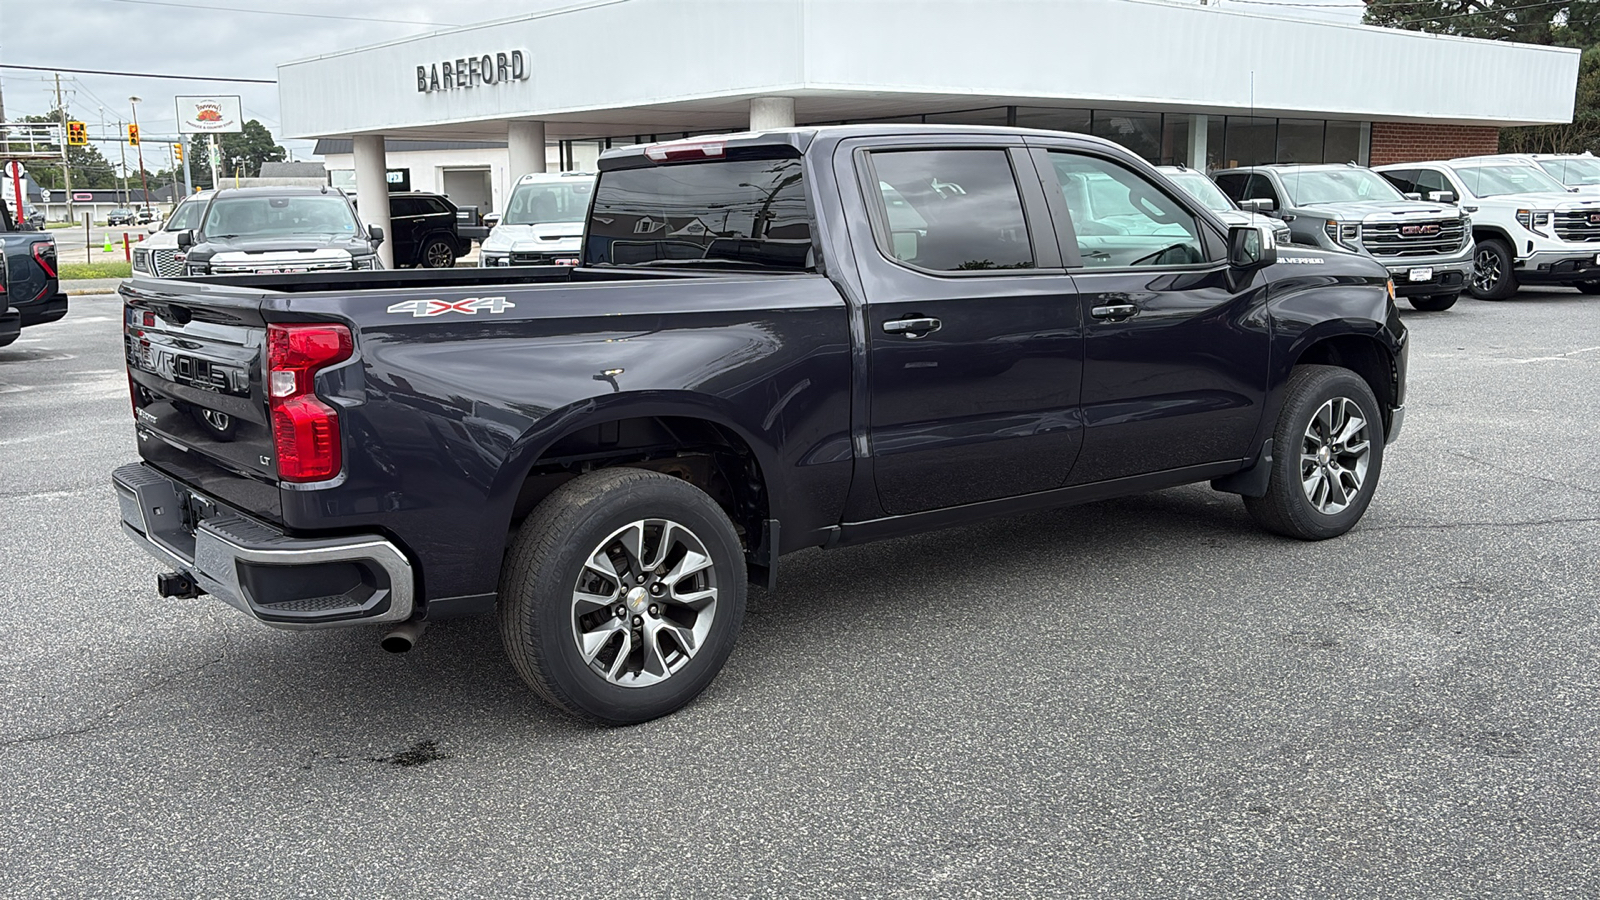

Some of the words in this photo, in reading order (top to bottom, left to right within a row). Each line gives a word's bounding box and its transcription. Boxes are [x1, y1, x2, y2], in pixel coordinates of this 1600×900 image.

[416, 49, 529, 93] BAREFORD
[1402, 224, 1440, 235] GMC
[124, 334, 251, 395] CHEVROLET
[259, 455, 271, 466] LT
